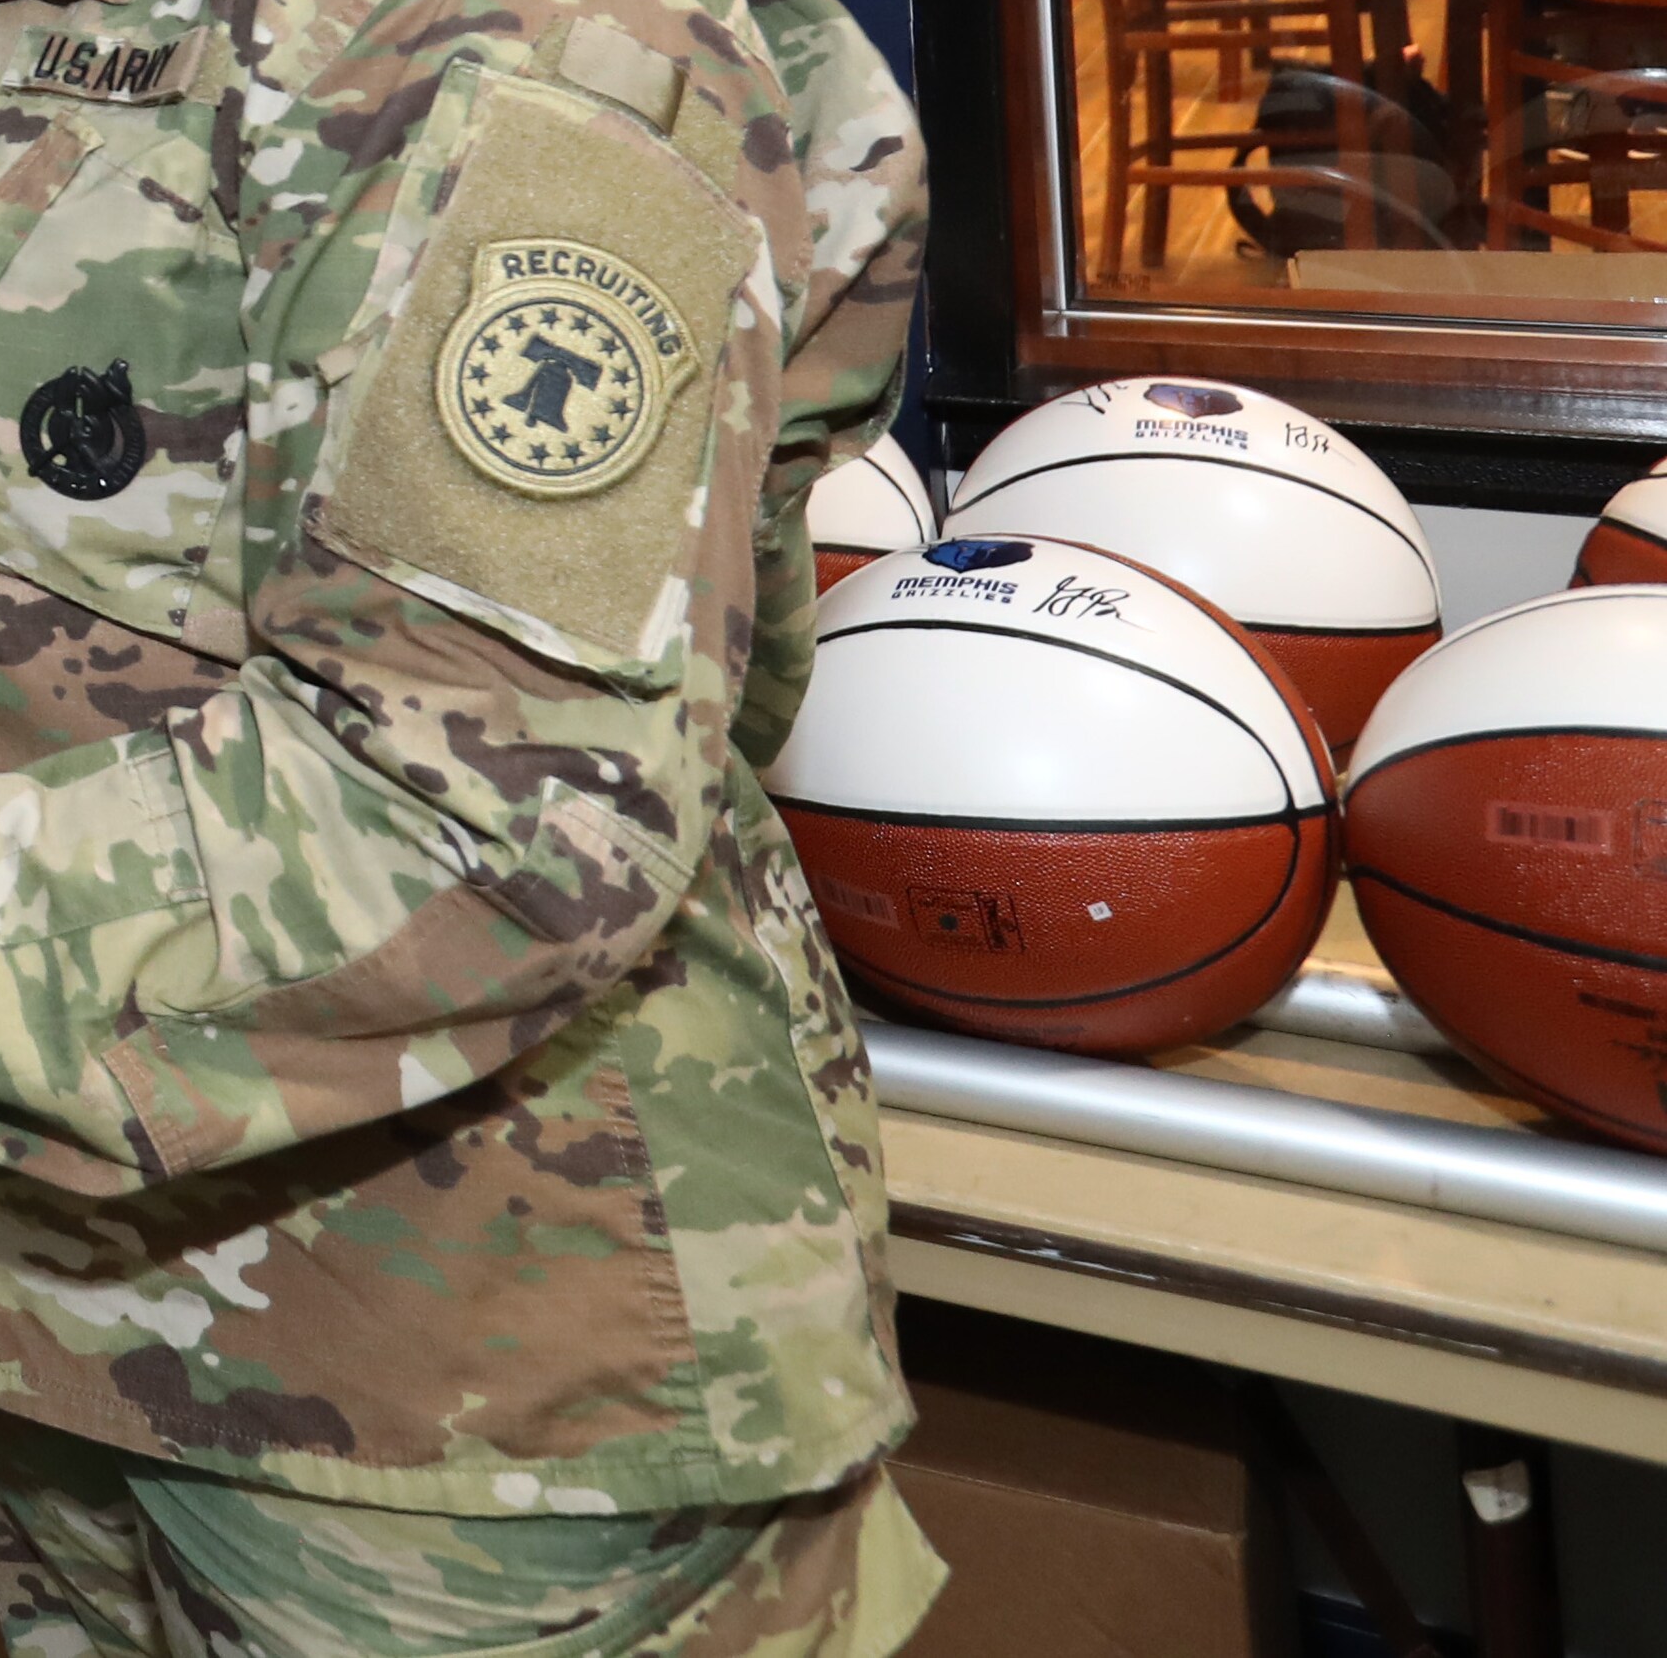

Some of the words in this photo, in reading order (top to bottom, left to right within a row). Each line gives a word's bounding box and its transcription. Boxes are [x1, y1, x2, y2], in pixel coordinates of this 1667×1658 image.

[501, 250, 682, 356] RECRUITING
[1136, 419, 1249, 441] MEMPHIS
[896, 576, 1019, 595] MEMPHIS
[892, 588, 1012, 604] GRIZZLIES
